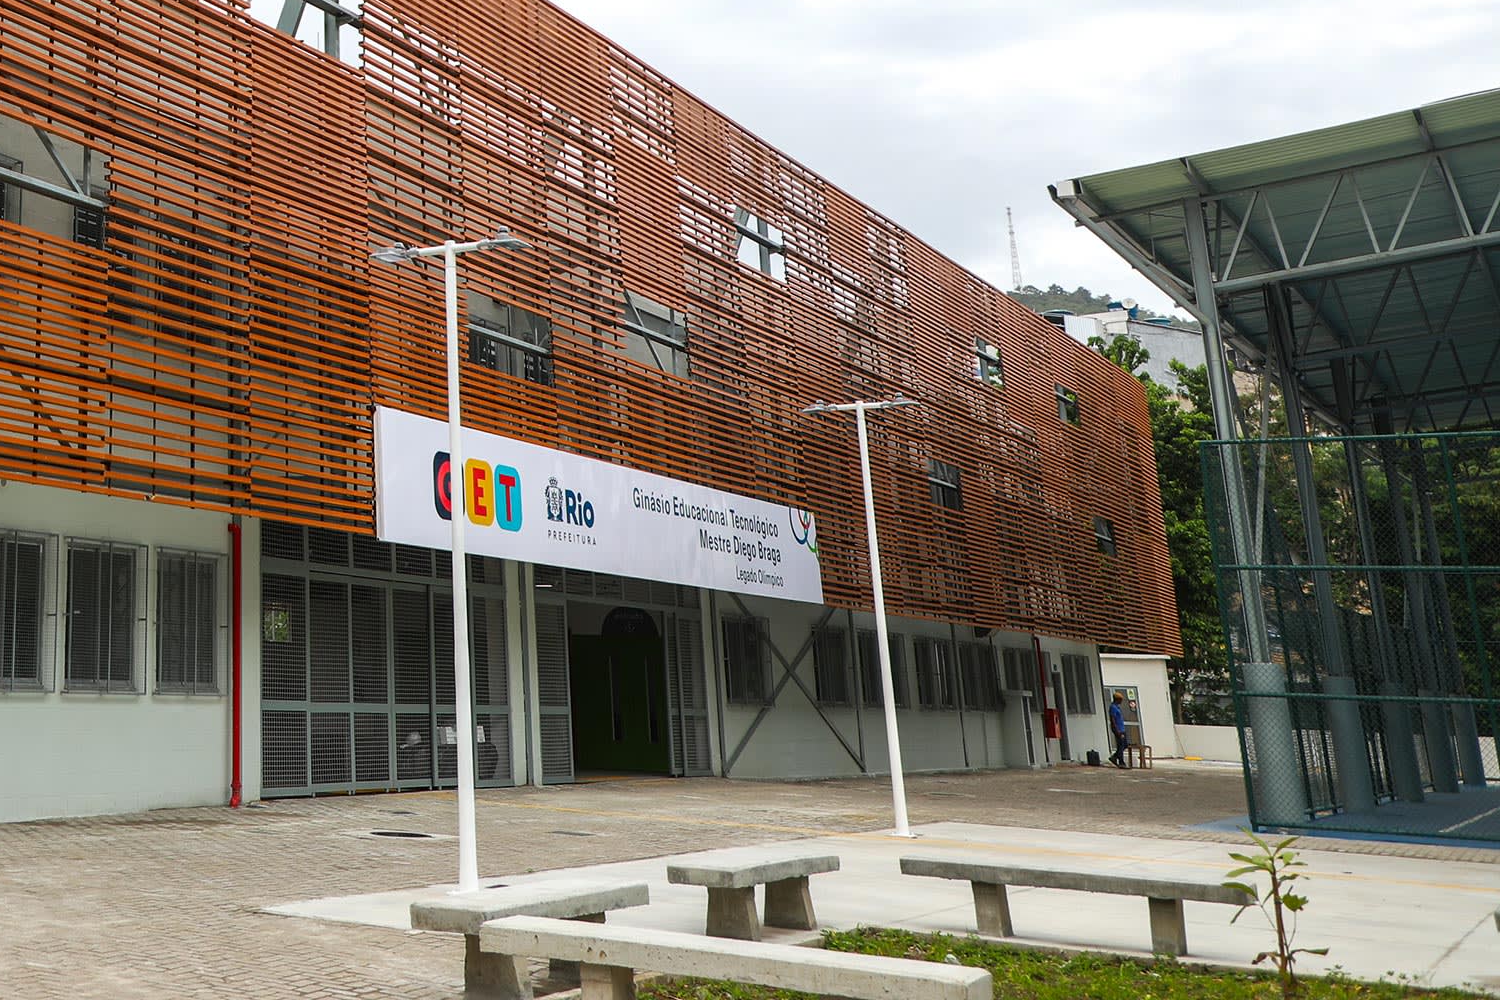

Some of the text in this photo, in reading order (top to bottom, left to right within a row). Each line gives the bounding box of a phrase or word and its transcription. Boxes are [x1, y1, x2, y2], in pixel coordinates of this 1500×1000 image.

[565, 489, 595, 528] Rio
[633, 487, 779, 539] Ginásio Educacional Tecnológico
[548, 529, 597, 546] PREFEITURA
[699, 529, 781, 566] Mestre Diego Braga
[735, 565, 757, 584] Legado
